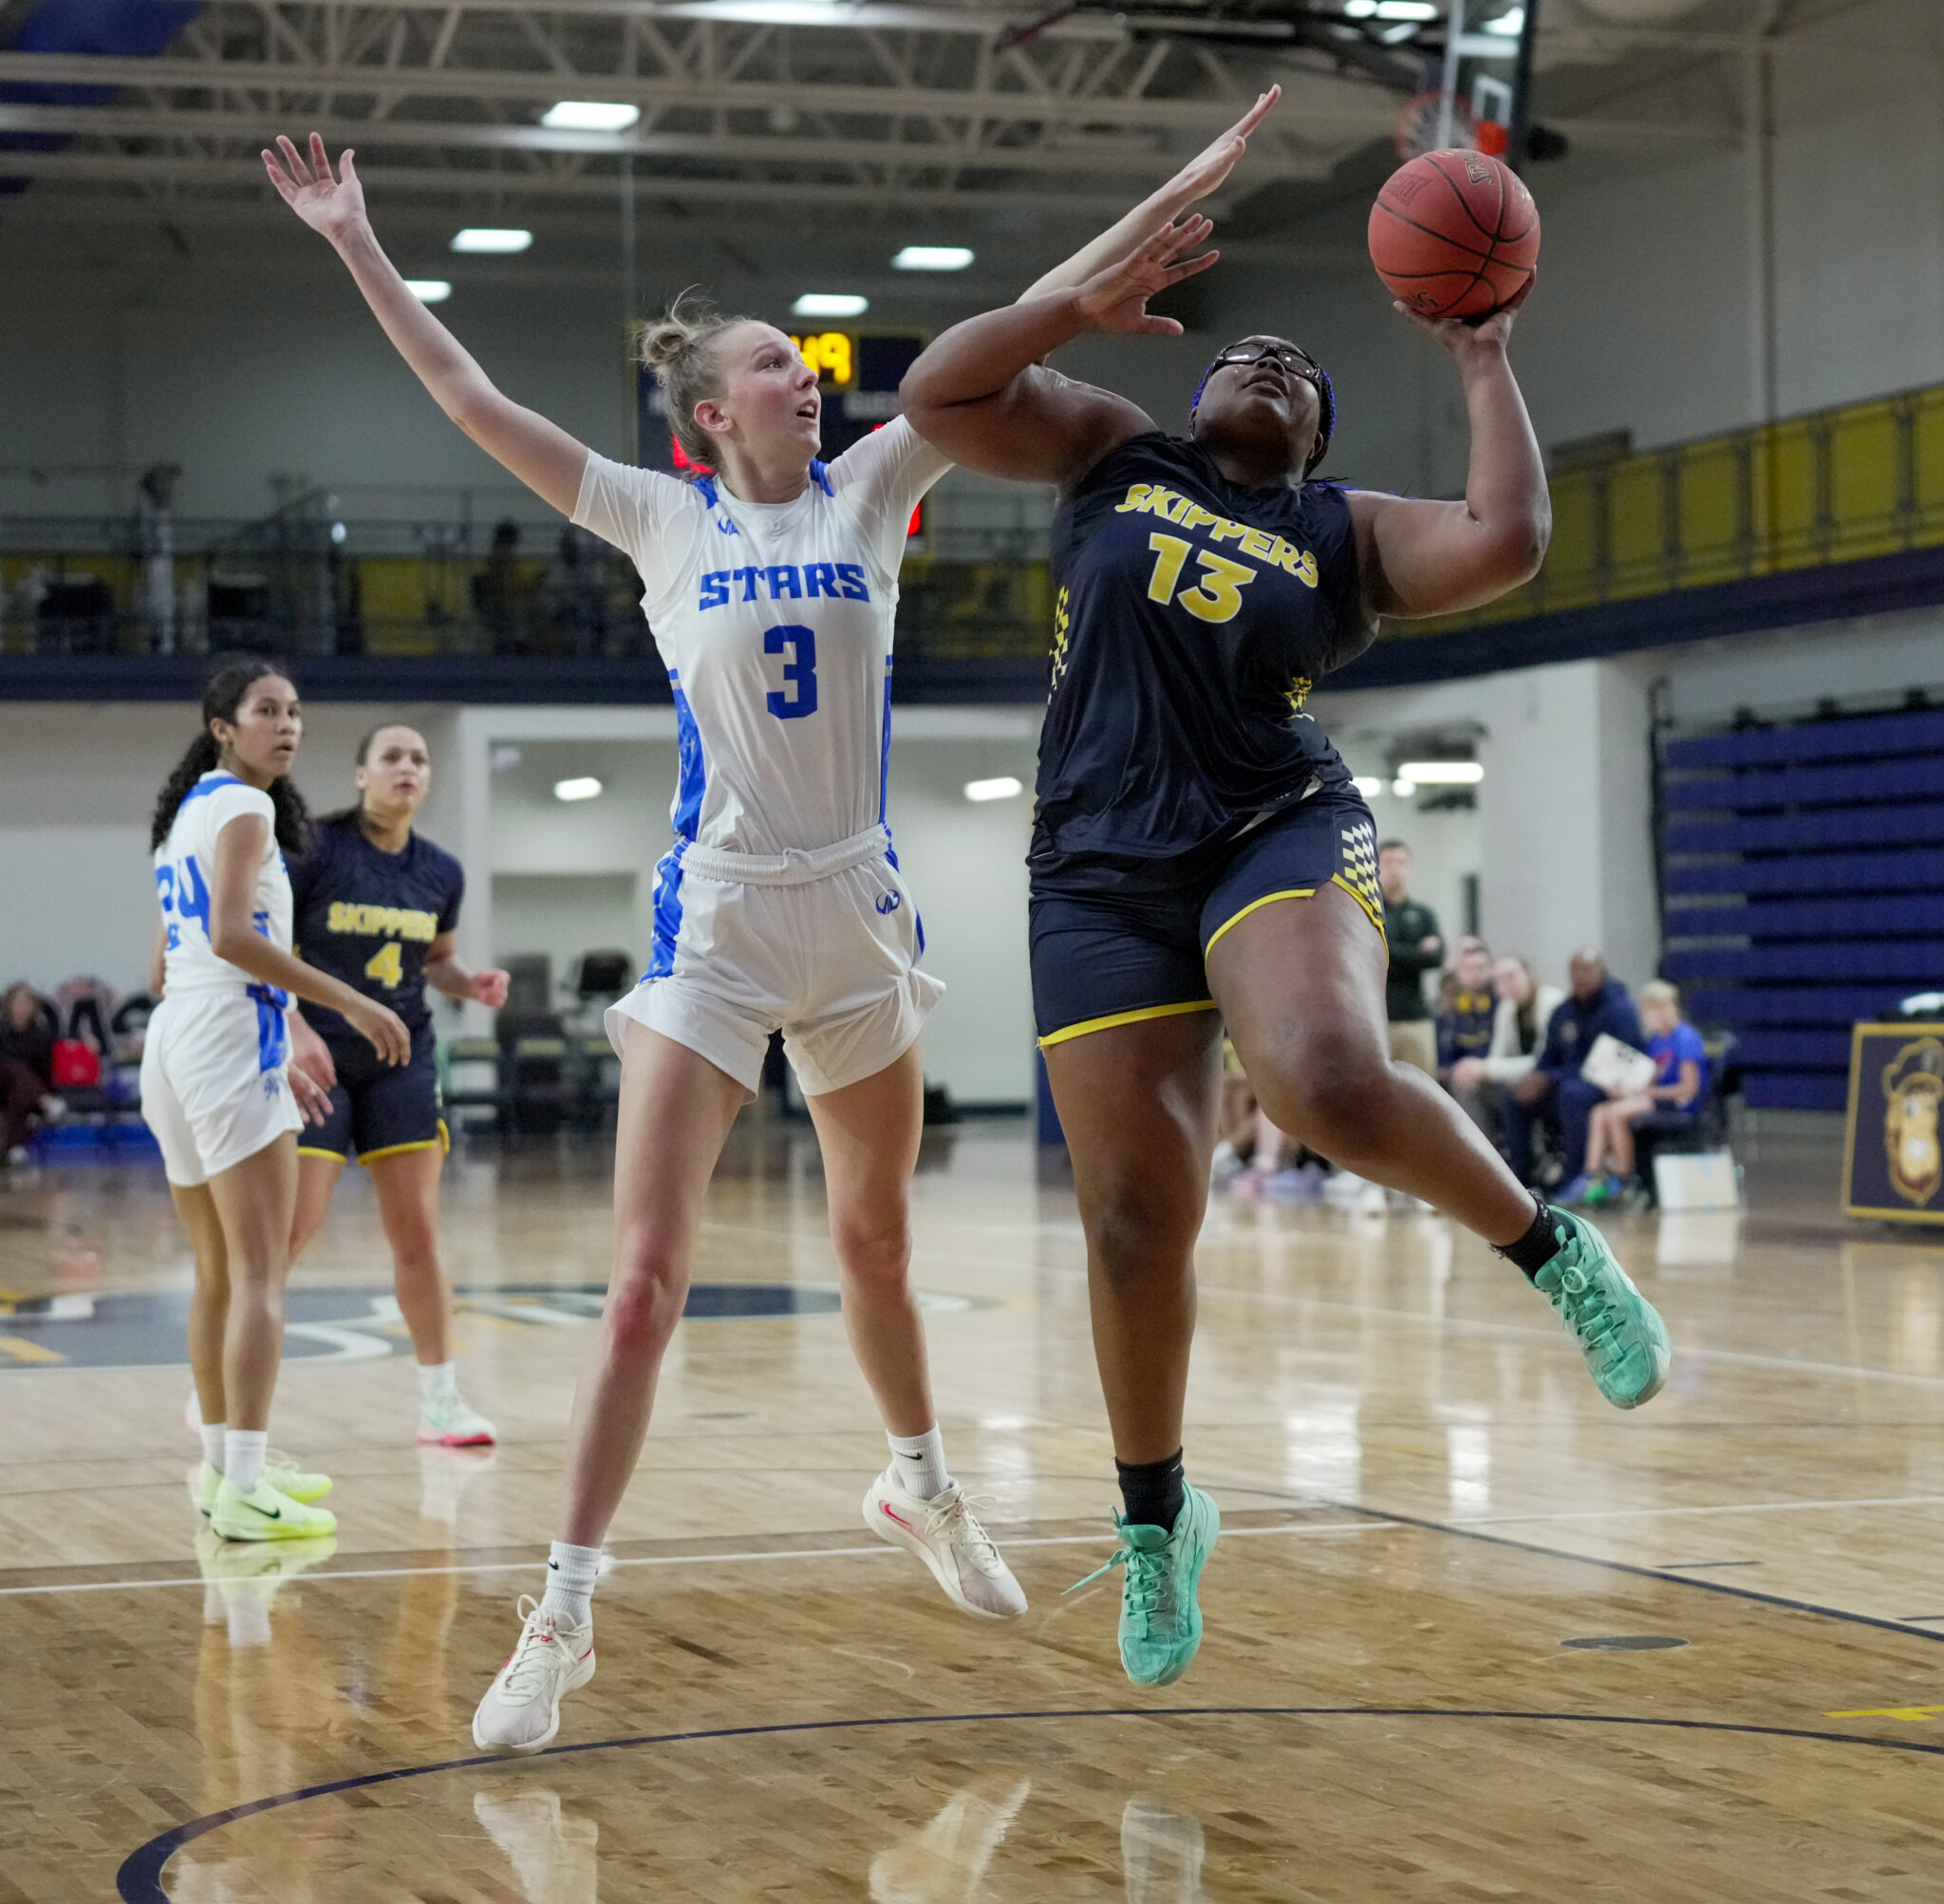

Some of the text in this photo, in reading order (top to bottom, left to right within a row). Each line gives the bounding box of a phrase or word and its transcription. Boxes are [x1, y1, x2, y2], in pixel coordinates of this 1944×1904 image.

[1114, 483, 1318, 588] SKIPPERS
[699, 562, 870, 611] STARS
[1148, 532, 1258, 624] 13
[764, 625, 817, 719] 3
[327, 902, 438, 942] SKIPPERS
[365, 941, 403, 989] 4
